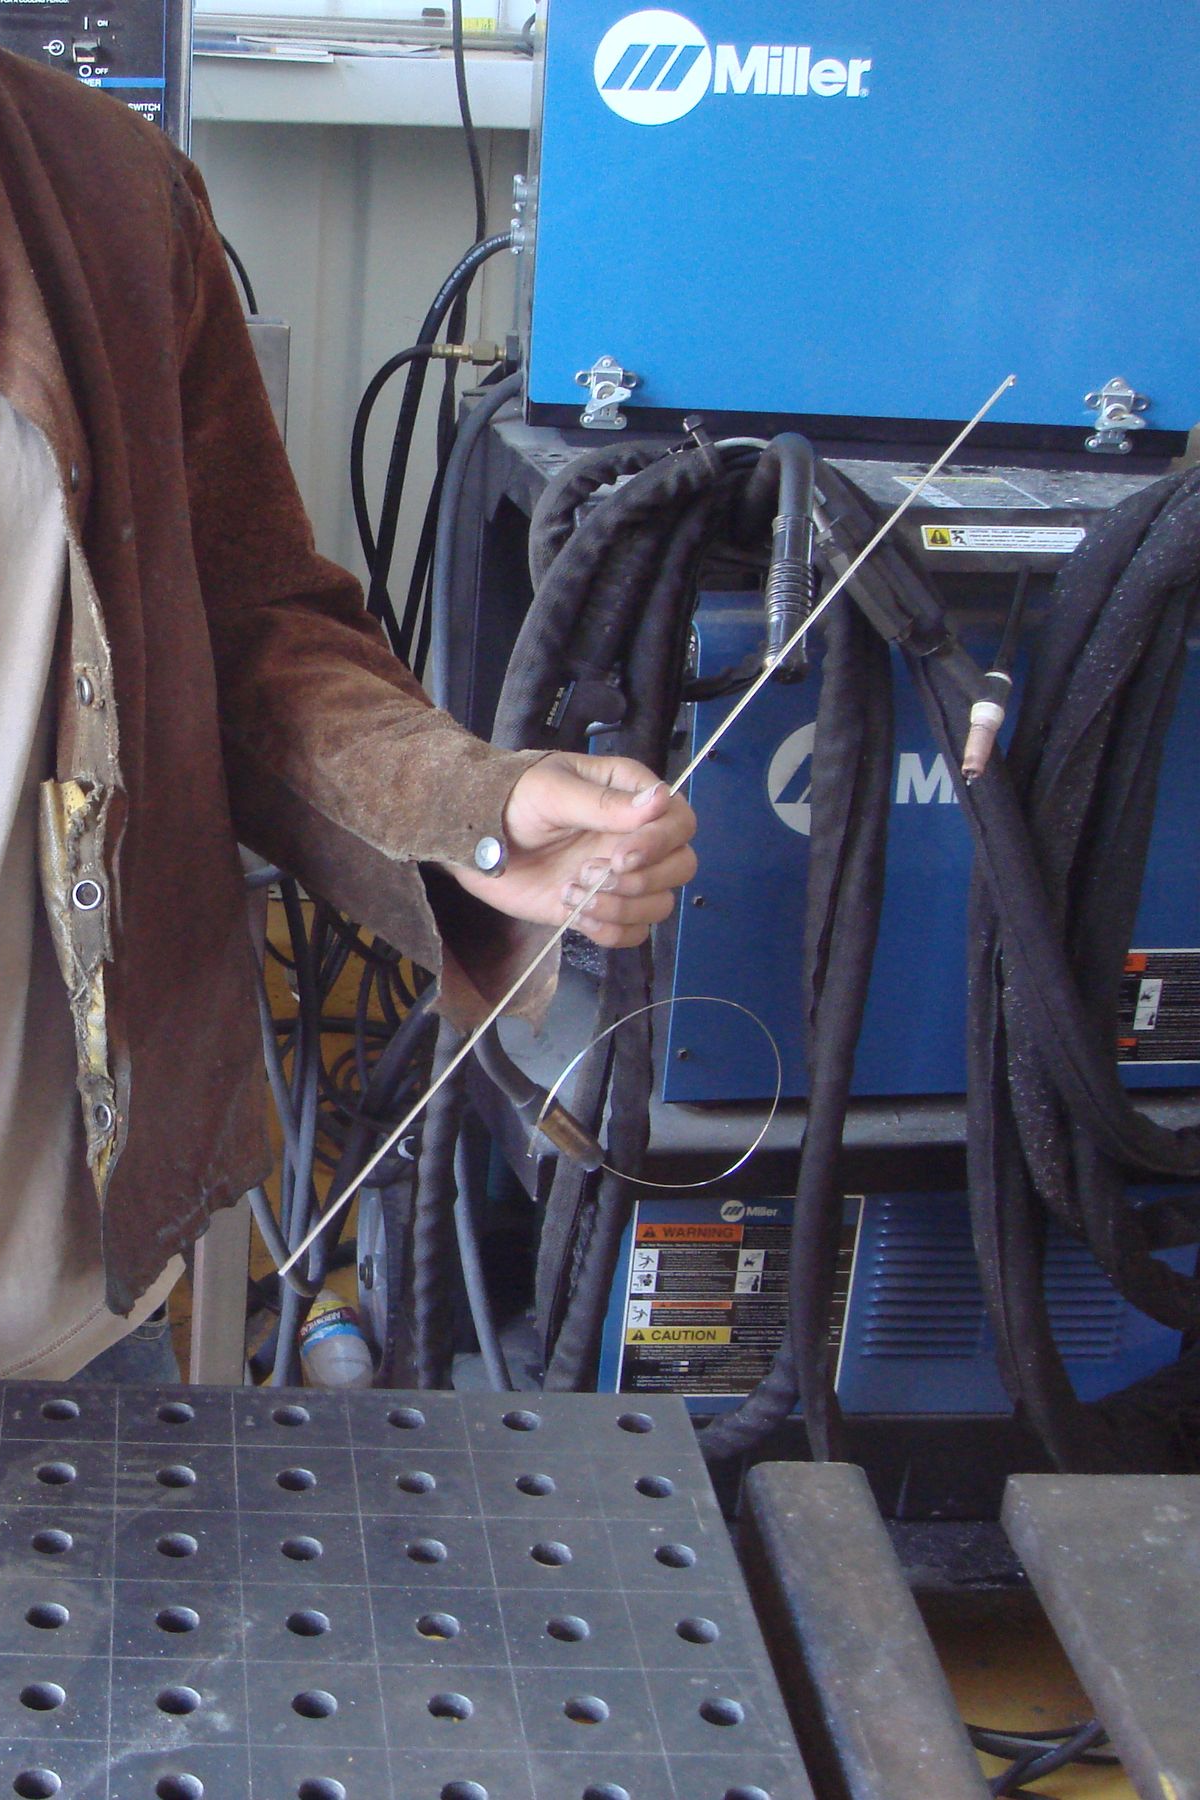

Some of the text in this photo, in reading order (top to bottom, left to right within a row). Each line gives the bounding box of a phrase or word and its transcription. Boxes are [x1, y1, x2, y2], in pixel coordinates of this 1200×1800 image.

[713, 44, 872, 97] Miller
[745, 1206, 779, 1217] Miller
[662, 1226, 734, 1239] WARNING
[651, 1330, 717, 1342] CAUTION
